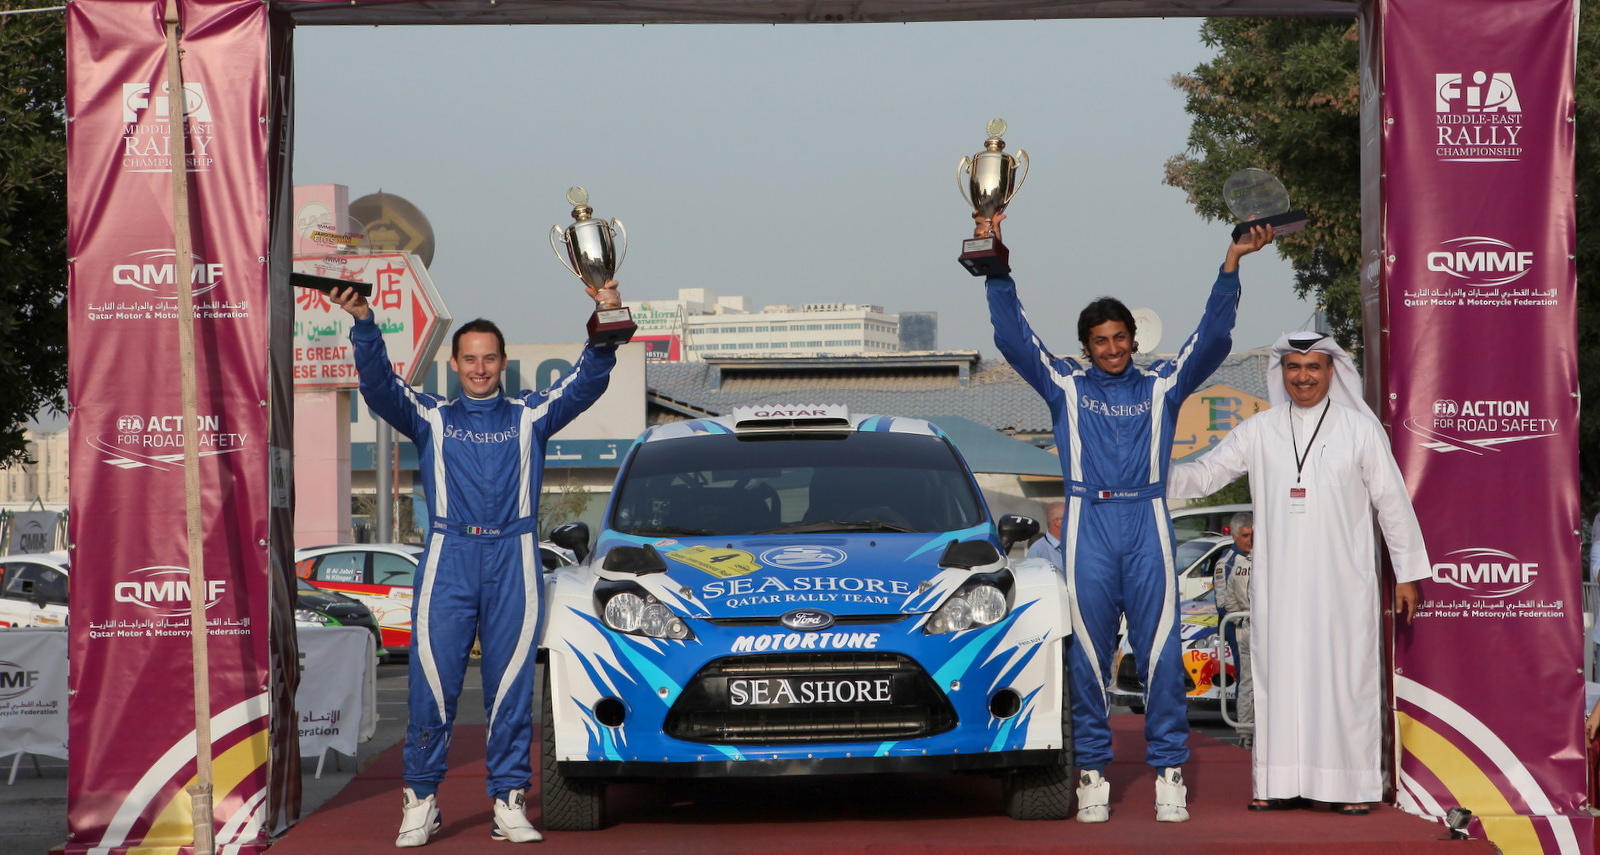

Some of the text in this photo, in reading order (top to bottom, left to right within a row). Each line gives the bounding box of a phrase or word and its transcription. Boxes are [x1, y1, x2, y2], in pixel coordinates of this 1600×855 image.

[1436, 115, 1522, 124] MIDDLE-EAST
[1437, 126, 1523, 146] RALLY
[1436, 148, 1523, 156] CHAMPIONSHIP
[123, 158, 213, 167] CHAMPISHIP
[1427, 252, 1533, 274] QMMF
[1404, 299, 1428, 307] Qatar
[1467, 299, 1512, 307] Motorcycle
[88, 312, 113, 320] Qatar
[307, 347, 347, 361] GREAT
[1080, 395, 1151, 416] SEASHORE
[1461, 401, 1529, 417] ACTION
[754, 409, 826, 417] QATAR
[147, 415, 219, 432] ACTN
[1434, 418, 1558, 432] FOR ROAD SAFETY
[117, 434, 247, 447] FOR ROAD AFETY
[443, 424, 519, 444] SEASHORE
[710, 553, 740, 563] 4
[1235, 566, 1251, 576] Qat
[1432, 563, 1538, 586] QMMF
[702, 577, 912, 599] SEASHORE
[726, 593, 889, 609] QATAR RALLY TEAM
[792, 613, 821, 626] Ford
[1472, 610, 1516, 619] Motorcycle
[90, 630, 114, 639] Qatar
[730, 632, 881, 653] MOTORTUNE
[1191, 646, 1219, 662] Red
[730, 678, 892, 706] SEASHORE
[21, 708, 58, 716] Federation
[298, 726, 339, 737] eration
